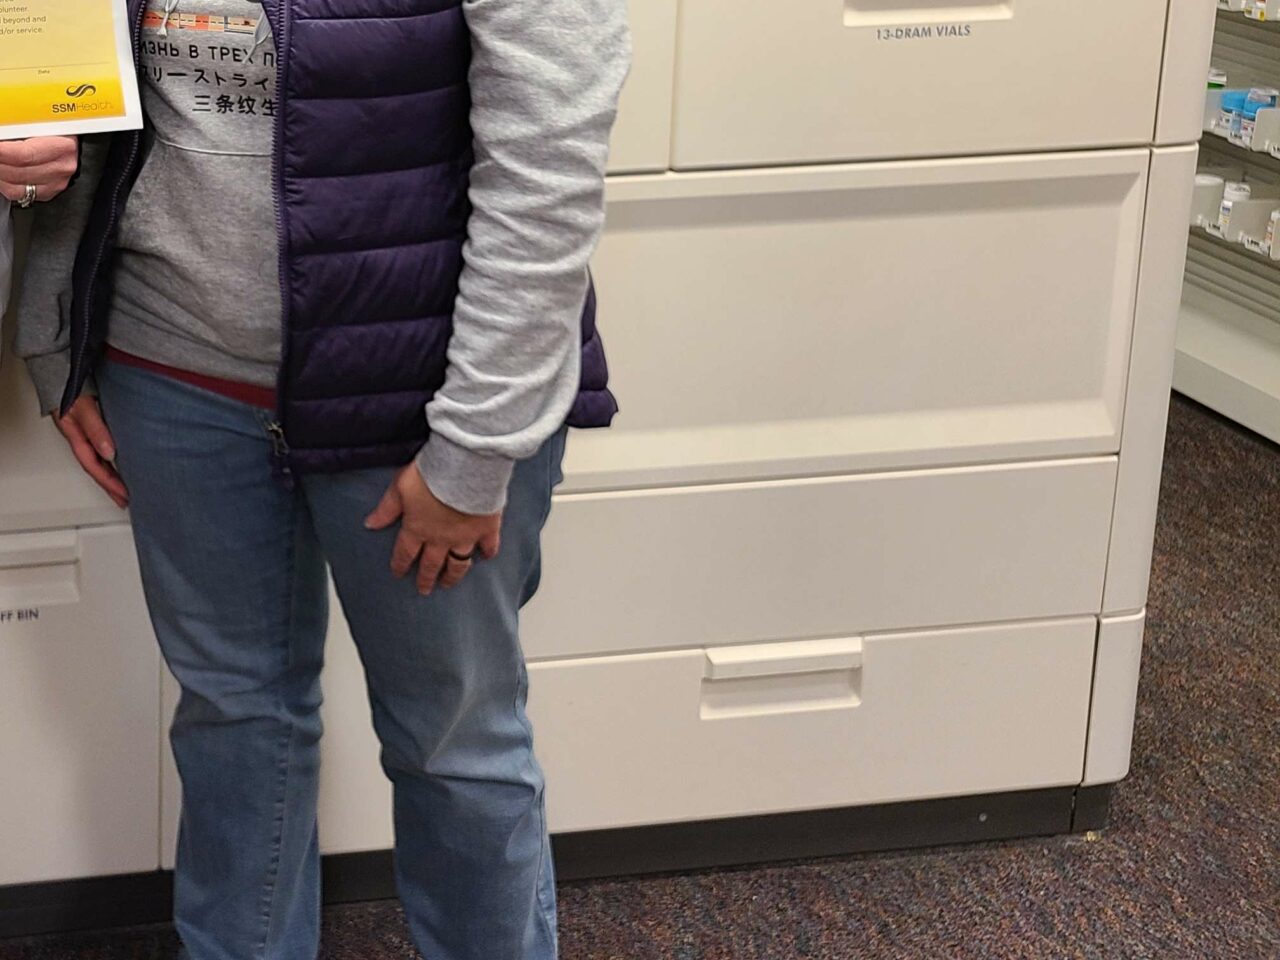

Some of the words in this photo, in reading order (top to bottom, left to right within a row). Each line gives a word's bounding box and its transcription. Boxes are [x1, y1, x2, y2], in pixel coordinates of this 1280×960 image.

[3, 16, 30, 25] beyond
[876, 26, 932, 40] 13-DRAM
[936, 24, 971, 37] VIALS
[17, 608, 40, 622] BIN
